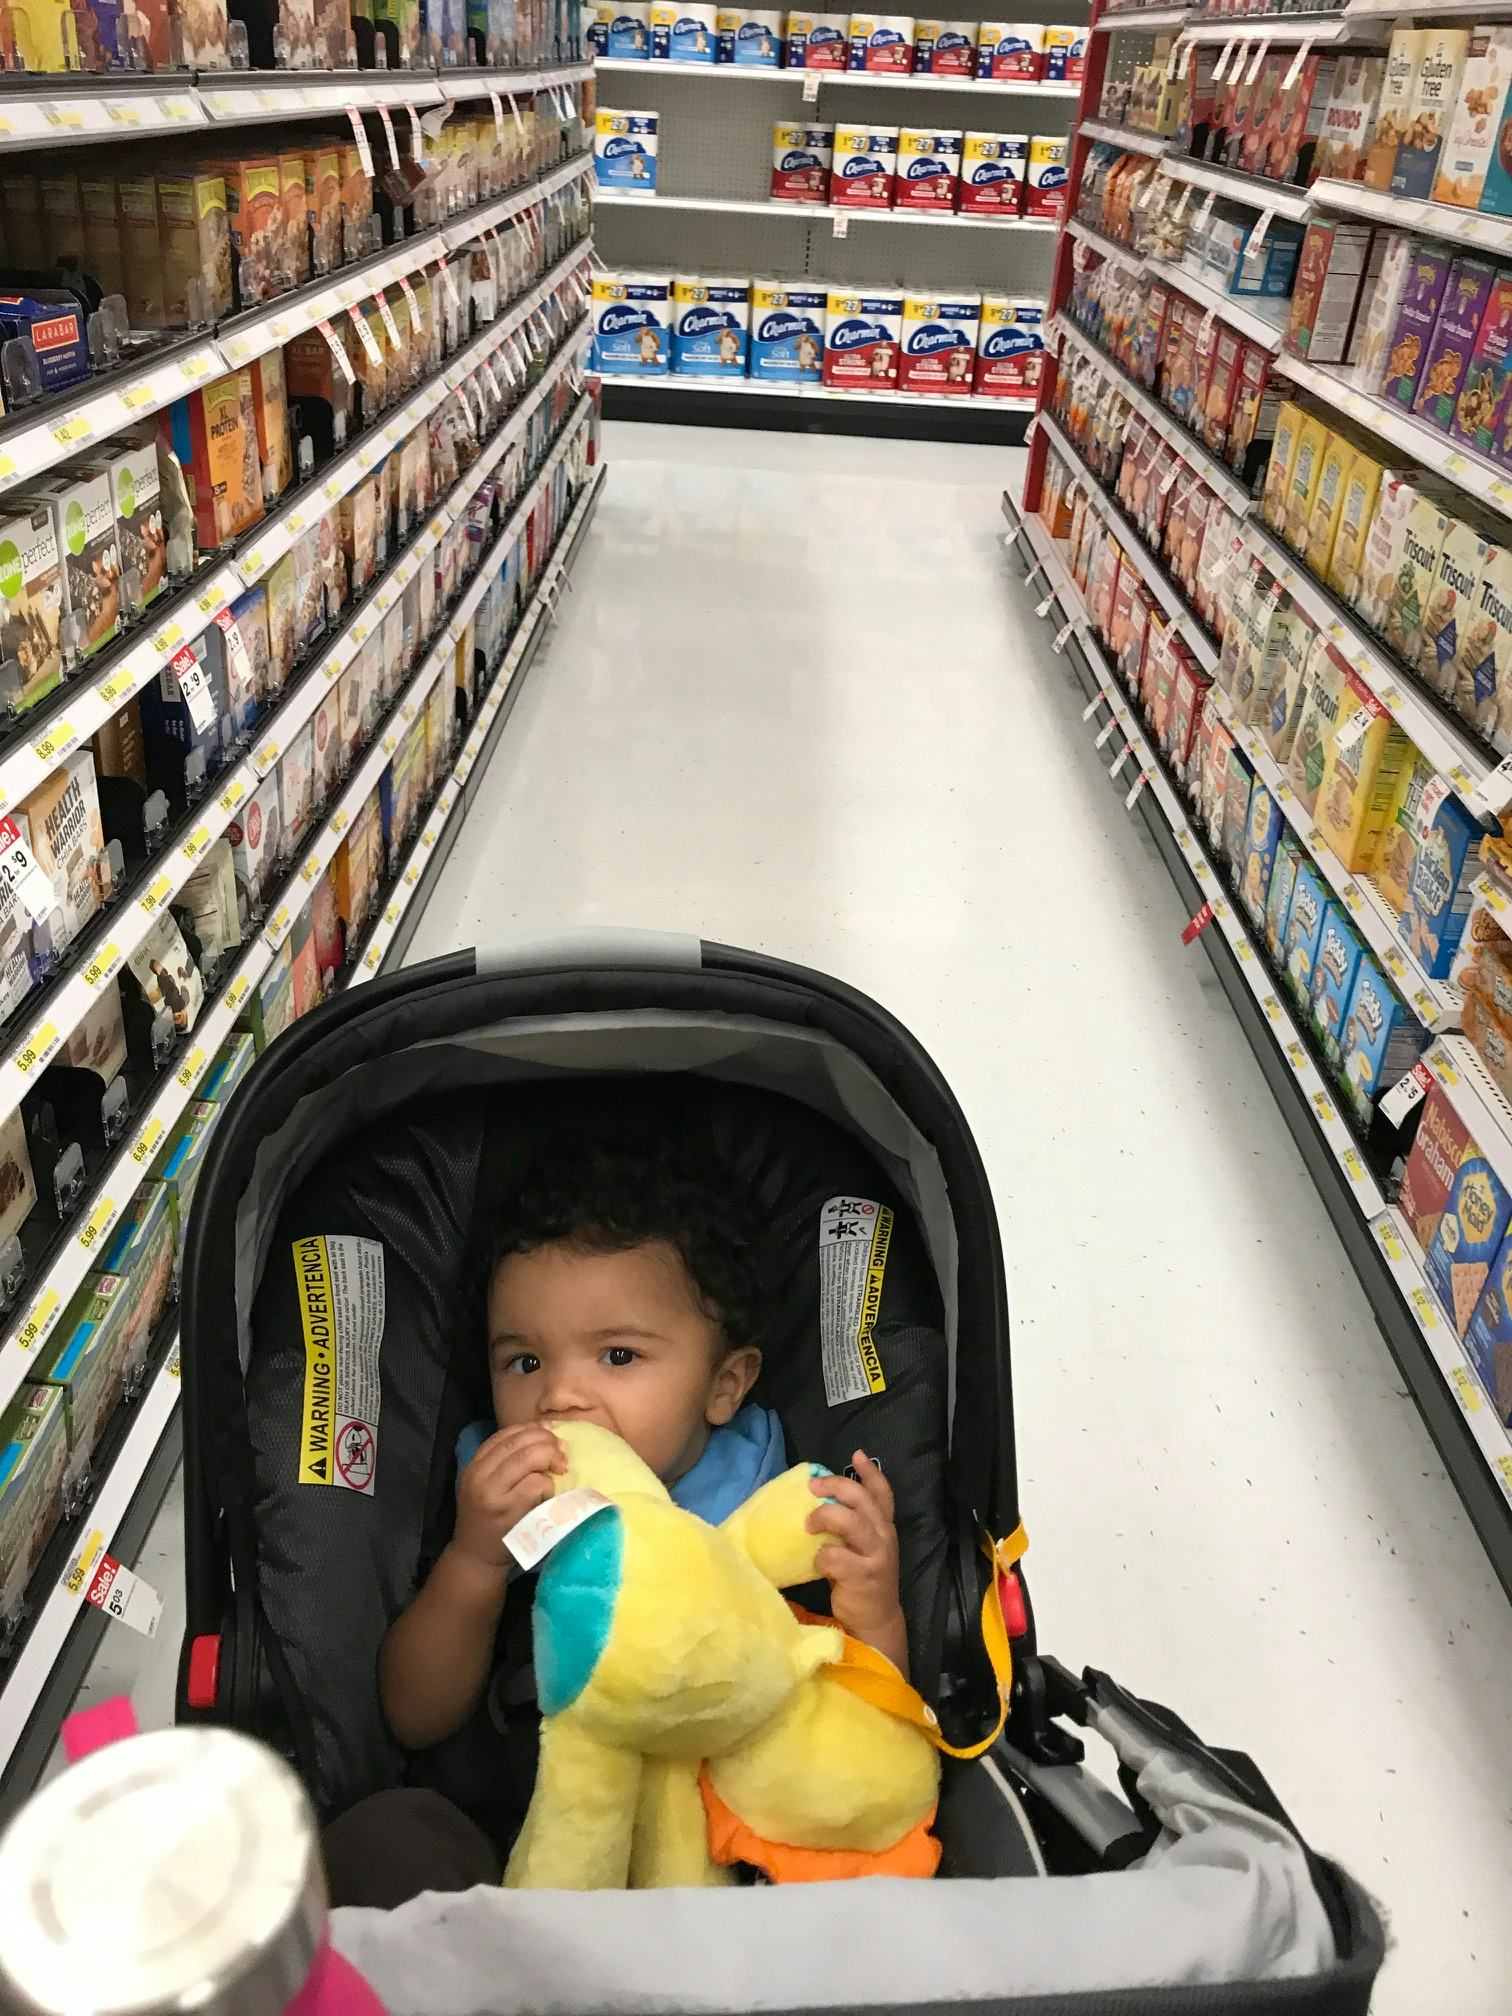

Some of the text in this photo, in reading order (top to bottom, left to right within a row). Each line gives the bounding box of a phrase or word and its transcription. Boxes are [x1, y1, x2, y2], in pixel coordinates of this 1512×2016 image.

[610, 286, 624, 297] 27
[691, 288, 705, 299] 27
[771, 293, 784, 304] 27
[844, 300, 858, 311] 27
[923, 305, 936, 316] 27
[1000, 309, 1013, 320] 27
[602, 312, 647, 330] Charmin
[684, 313, 727, 332] Charmin
[763, 319, 807, 337] Charmin
[36, 322, 74, 342] LARABAR
[835, 327, 880, 345] Charmin
[912, 332, 958, 350] Charmin
[988, 336, 1034, 353] Charmin
[219, 406, 228, 419] XL
[54, 428, 72, 443] 1.42
[211, 417, 239, 440] PROTEIN
[84, 499, 113, 533] perfect
[21, 535, 57, 574] perfect
[1403, 527, 1436, 572] Triscuit
[1439, 552, 1476, 600] Triscuit
[1480, 580, 1512, 634] Triscui
[217, 611, 234, 631] Sale!
[154, 638, 169, 652] 4.99
[173, 651, 194, 676] Sale!
[100, 685, 116, 701] 8.99
[183, 672, 200, 696] 2 $9
[1311, 670, 1339, 723] Triscui
[36, 741, 55, 759] 8.99
[45, 776, 82, 841] HEALTH
[220, 796, 232, 811] 7.99
[51, 799, 86, 858] WARRIOR
[57, 822, 88, 869] CHIA BARS
[183, 842, 197, 858] 7.99
[2, 865, 15, 882] 2
[12, 851, 27, 868] $9
[141, 895, 157, 912] 7.99
[85, 965, 102, 984] 5.99
[17, 1049, 36, 1071] 5.99
[179, 1070, 192, 1086] 5.99
[1400, 1078, 1410, 1088] 2
[1412, 1065, 1431, 1089] Sale!
[1426, 1101, 1463, 1168] Nabisco
[133, 1142, 148, 1162] 6.99
[1416, 1121, 1455, 1192] Graham
[1464, 1180, 1494, 1221] Honey
[1462, 1203, 1484, 1233] Maid
[80, 1225, 98, 1248] 5.99
[873, 1211, 893, 1267] WARNING
[854, 1284, 863, 1326] STRANGLED
[19, 1324, 38, 1348] 5.99
[861, 1285, 883, 1383] ADVERTENCIA
[302, 1238, 330, 1452] WARNING ADVERTENCIA
[345, 1380, 350, 1390] OR
[338, 1402, 343, 1412] DO
[69, 1568, 85, 1592] 5.59
[91, 1562, 116, 1604] Sale!
